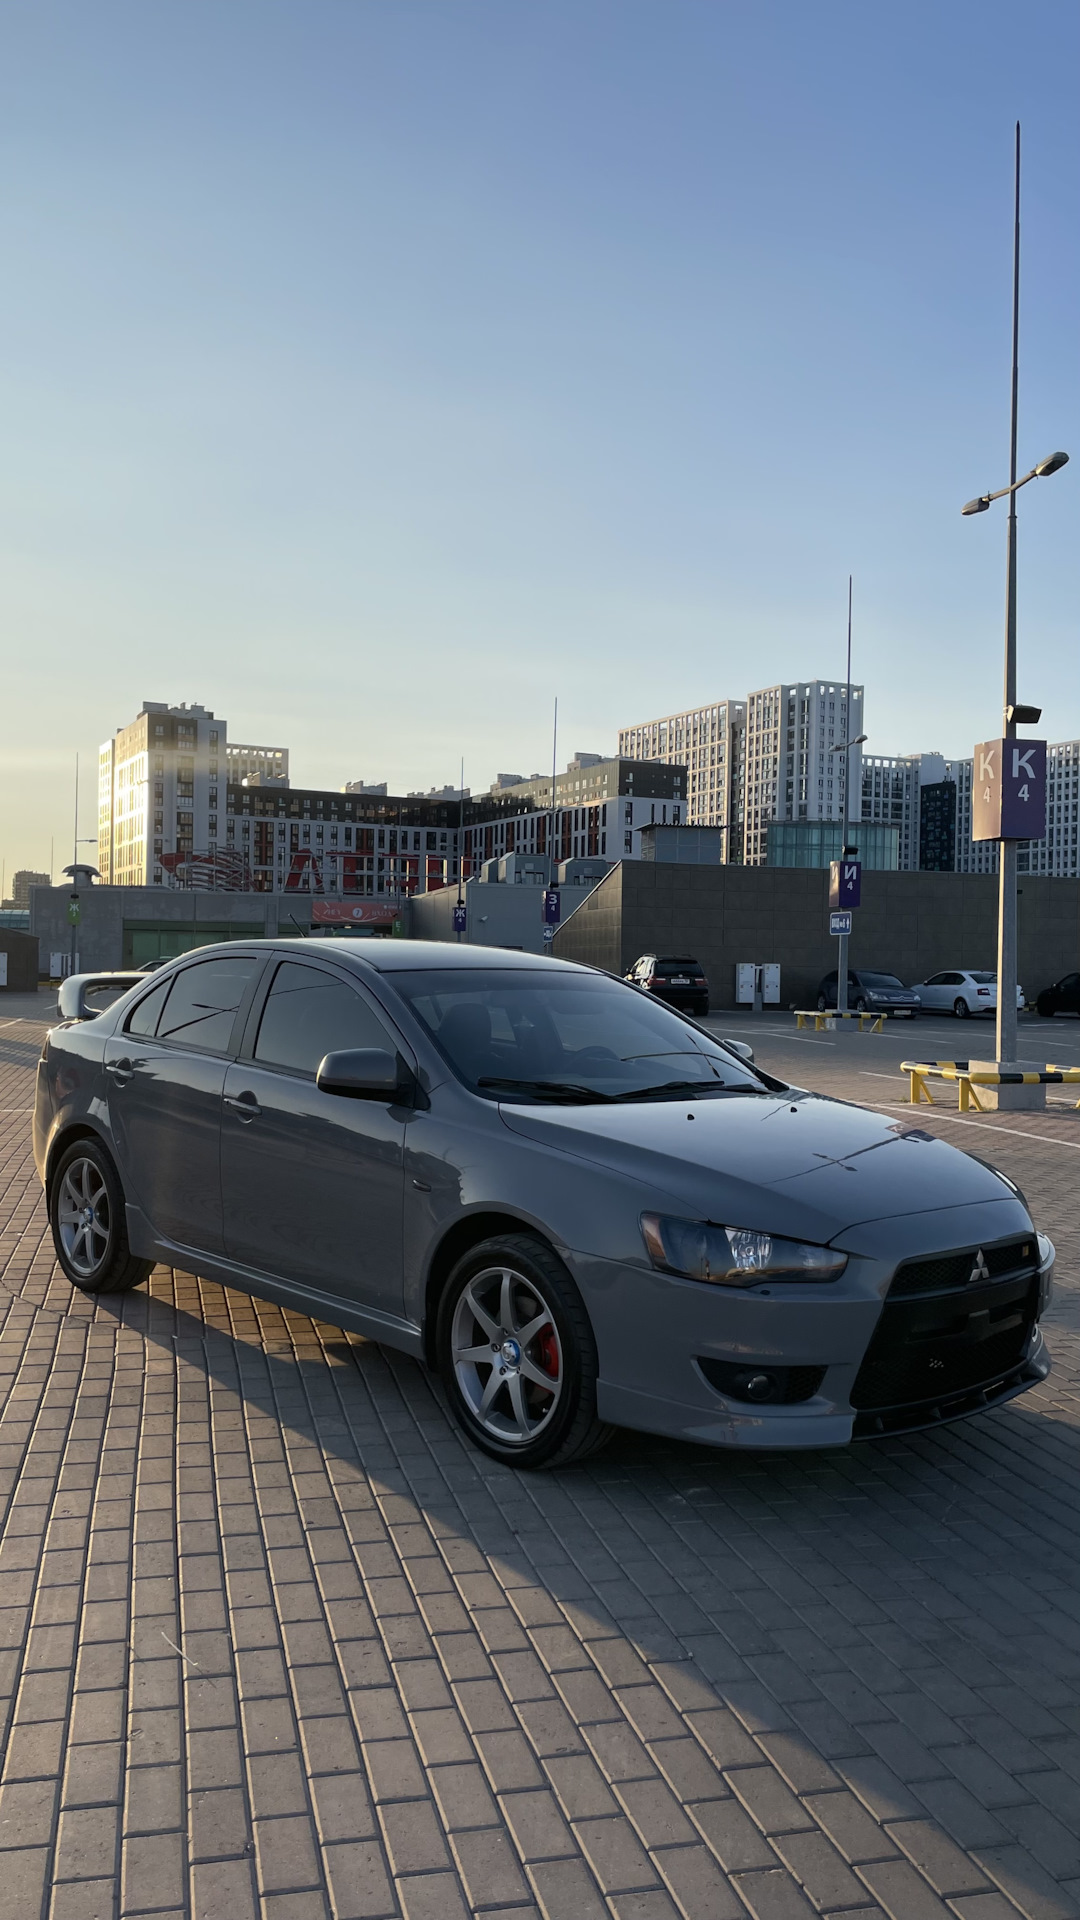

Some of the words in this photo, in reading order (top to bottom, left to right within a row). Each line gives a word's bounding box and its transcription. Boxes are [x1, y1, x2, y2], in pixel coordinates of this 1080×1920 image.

[1012, 748, 1036, 779] К
[983, 786, 991, 803] 4
[1018, 784, 1030, 802] 4
[844, 865, 857, 880] И
[847, 881, 853, 891] 4
[455, 908, 465, 917] Ж
